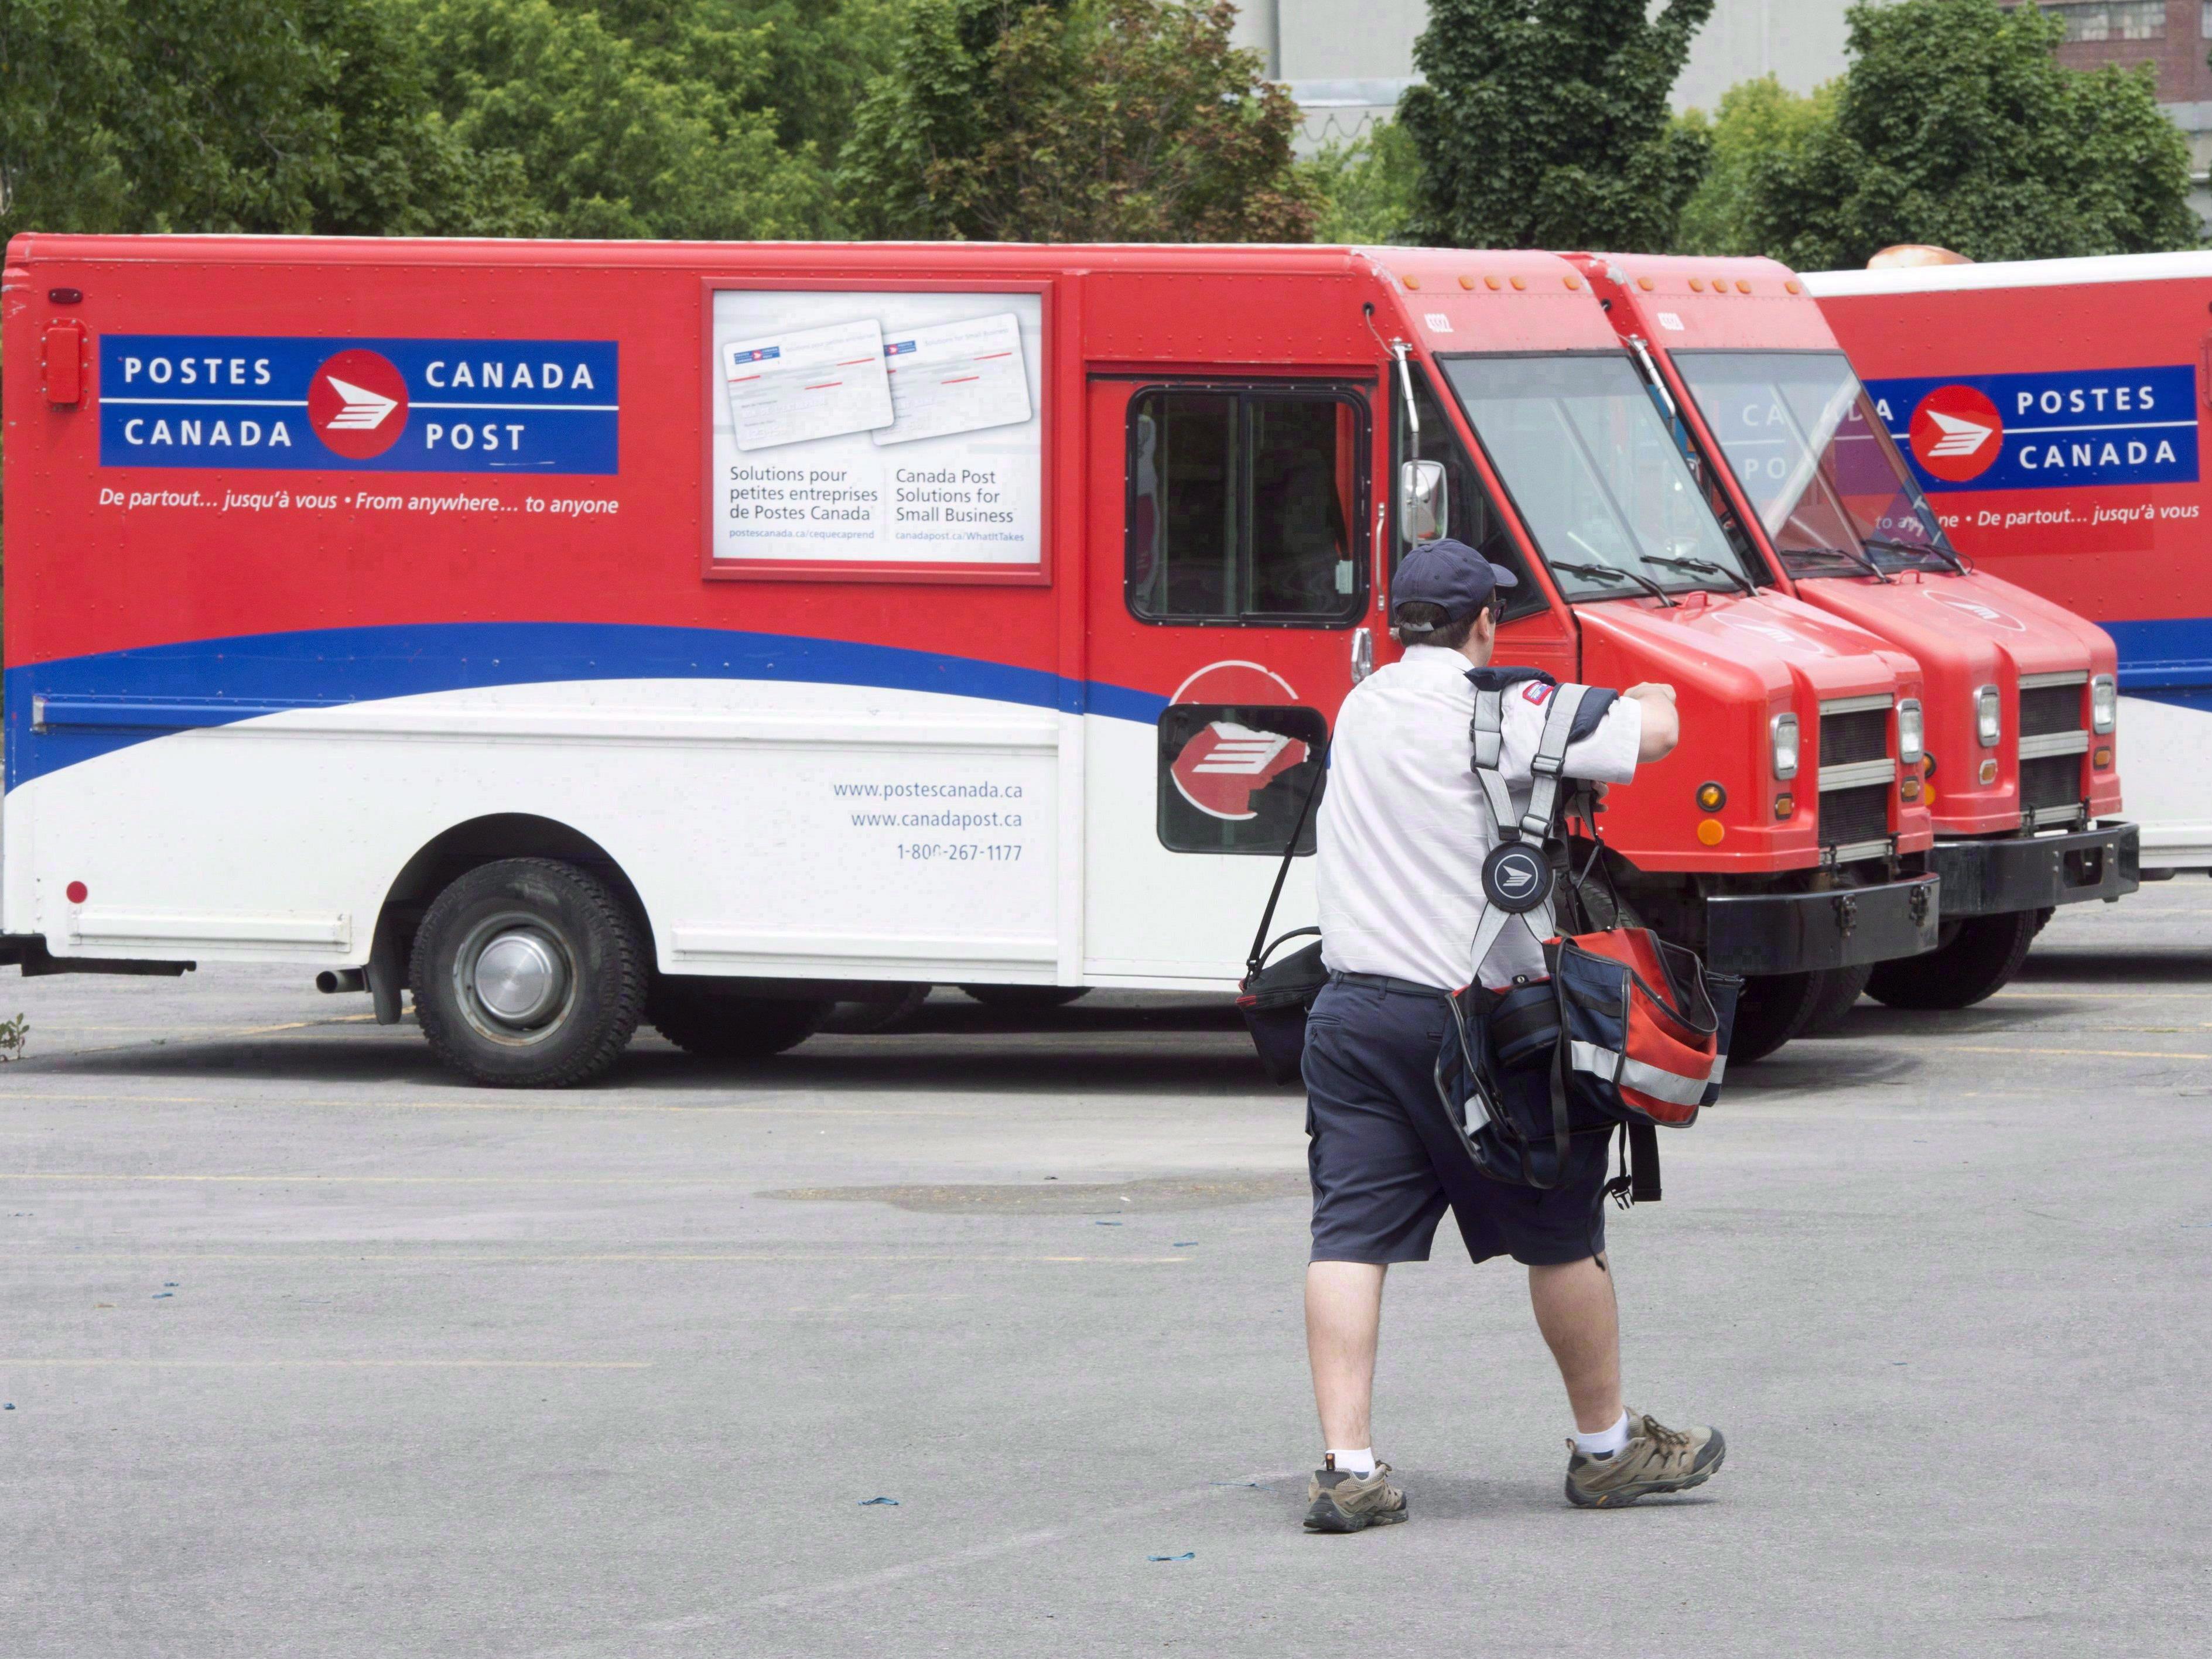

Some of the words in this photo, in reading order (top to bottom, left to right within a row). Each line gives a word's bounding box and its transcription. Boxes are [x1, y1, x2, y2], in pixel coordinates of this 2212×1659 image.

[125, 358, 270, 384] POSTES
[426, 362, 593, 389] CANADA
[2018, 386, 2153, 414] POSTES
[1742, 398, 1894, 427] CADA
[125, 419, 291, 446] CANADA
[427, 424, 524, 450] POST
[2020, 441, 2176, 468] CANADA
[731, 466, 804, 481] Solutions
[811, 471, 846, 486] pour
[897, 469, 955, 483] Canada
[962, 470, 995, 484] Post
[100, 488, 124, 505] De
[296, 495, 337, 508] vous
[356, 492, 402, 509] From
[526, 497, 545, 512] to
[550, 500, 618, 517] anyone
[731, 487, 784, 502] petites
[790, 488, 877, 504] entreprises
[897, 488, 970, 502] Solutions
[977, 488, 1000, 503] for
[730, 504, 748, 518] de
[755, 505, 805, 519] Postes
[811, 506, 869, 520] Canada
[897, 507, 938, 521] Small
[946, 508, 1013, 522] Business
[1978, 511, 2001, 526] De
[2160, 506, 2199, 518] vous
[729, 529, 874, 539] postescanada.ca/cequecaprend
[834, 781, 1021, 801] www.postescanada.ca
[852, 810, 1021, 830] www.canadapost.ca
